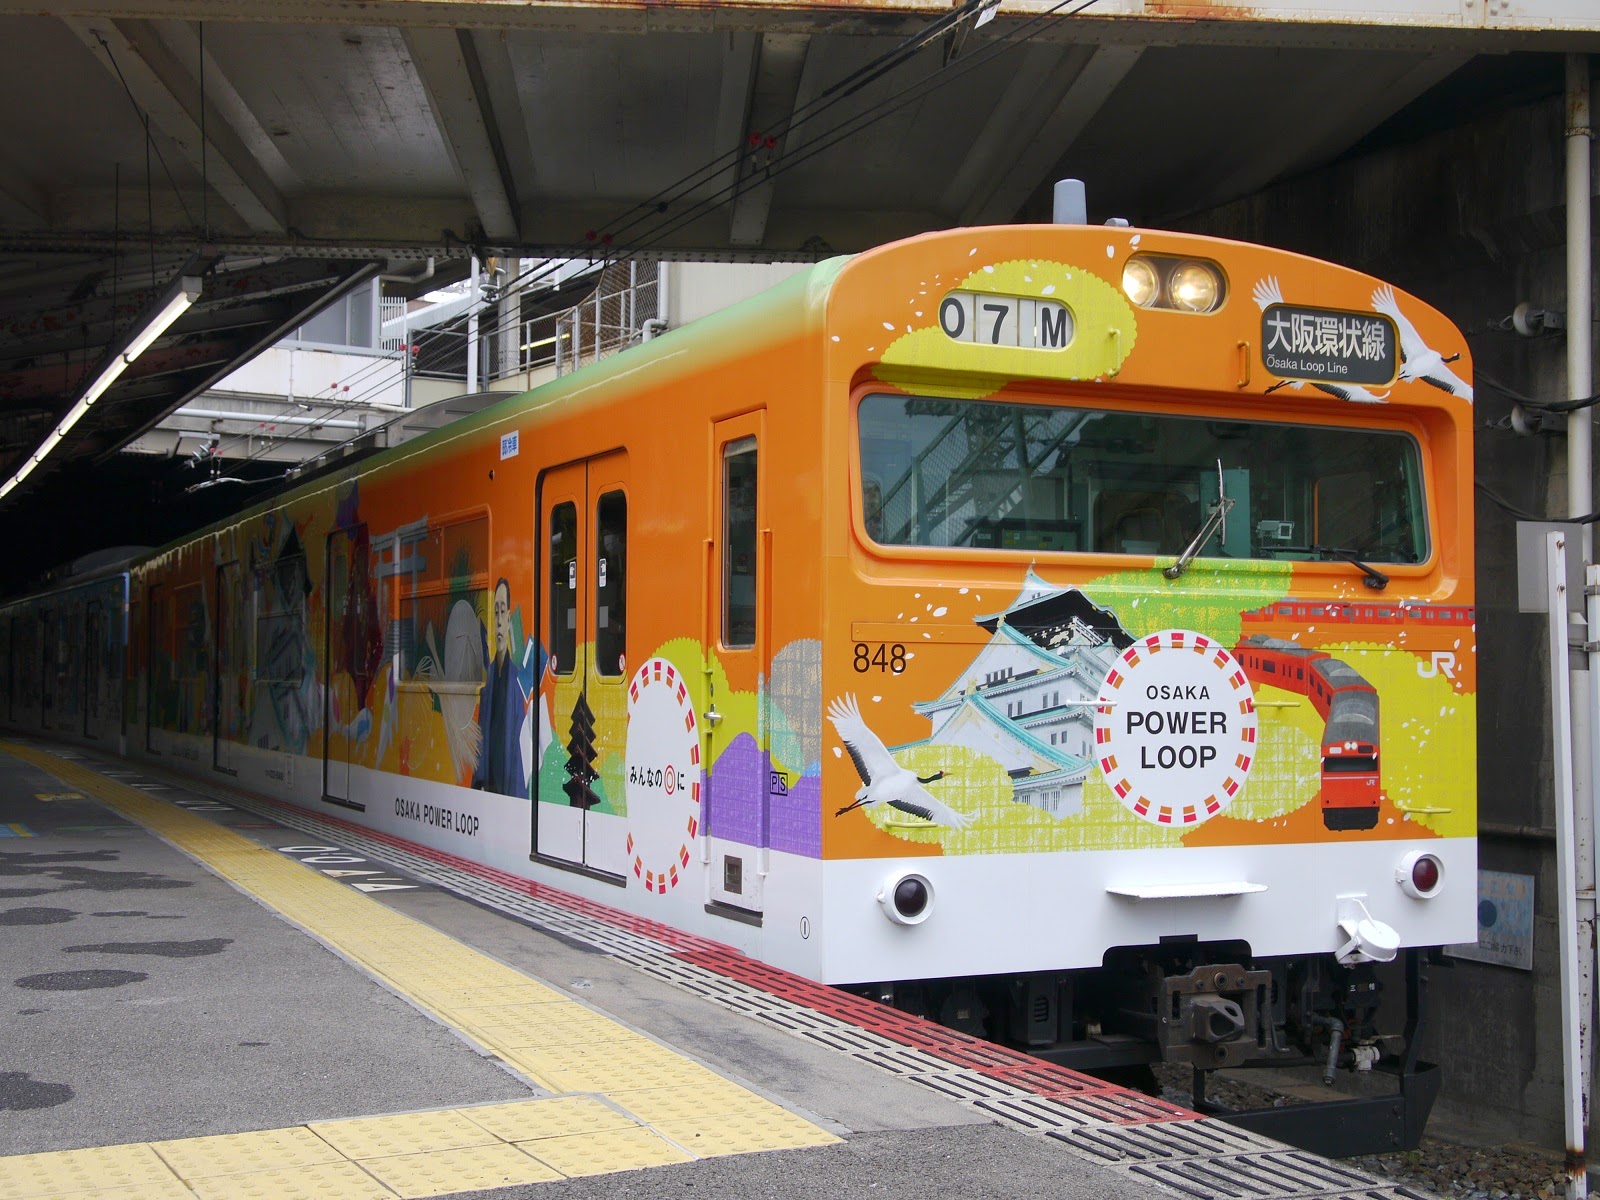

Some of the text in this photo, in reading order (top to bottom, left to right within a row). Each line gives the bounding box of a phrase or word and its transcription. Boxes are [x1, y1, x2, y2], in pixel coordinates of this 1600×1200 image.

[1266, 310, 1386, 361] 大阪環状線
[1300, 359, 1325, 374] Loop
[1327, 361, 1348, 375] Line
[853, 642, 907, 674] 848
[1417, 651, 1456, 679] JR
[1146, 685, 1210, 700] OSAKA
[1126, 710, 1228, 735] POWER
[1141, 745, 1217, 769] LOOP
[395, 797, 480, 837] OSAKA POWER LOOP
